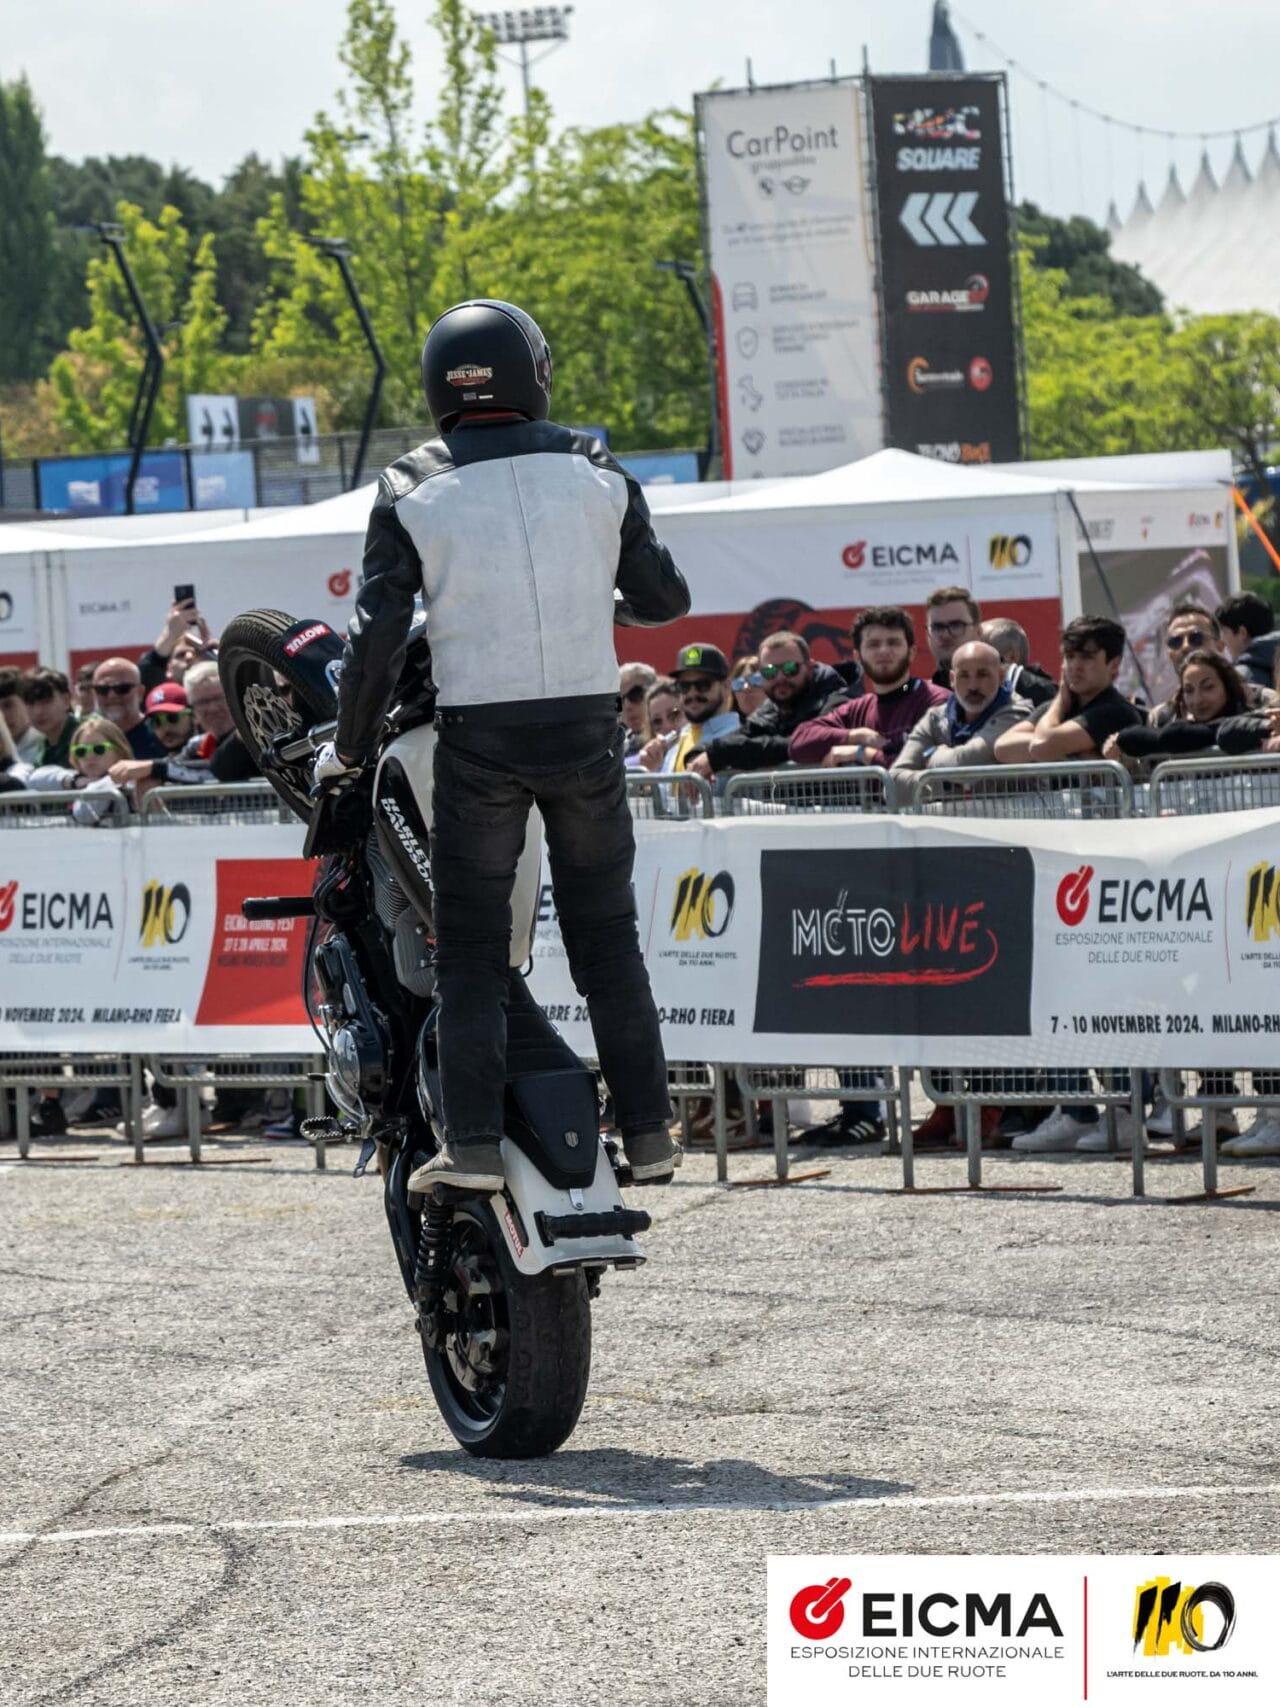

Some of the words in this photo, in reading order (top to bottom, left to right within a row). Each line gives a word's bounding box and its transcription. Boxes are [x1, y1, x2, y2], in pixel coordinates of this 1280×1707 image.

[727, 125, 838, 158] CarPoint
[897, 147, 981, 171] SQUARE
[872, 542, 959, 567] EICMA
[285, 623, 326, 653] MOTUL
[380, 798, 435, 892] DAVIDSON
[387, 797, 431, 868] HARLEY
[22, 892, 114, 930] EICMA
[1098, 877, 1213, 923] EICMA
[1055, 931, 1124, 946] ESPOSIZIONE
[1126, 930, 1214, 945] INTERNAZIONALE
[1088, 951, 1120, 964] DELLE
[1122, 950, 1144, 963] DUE
[1145, 949, 1179, 963] RUOTE
[5, 1007, 55, 1023] NOVEMBRE
[91, 1007, 152, 1023] MILANO-RHO
[154, 1007, 182, 1023] FIERA
[659, 1006, 696, 1025] O-RHO
[700, 1007, 735, 1026] FIERA
[1051, 1015, 1059, 1034] 7
[1072, 1015, 1088, 1034] 10
[1091, 1014, 1162, 1034] NOVEMBRE
[1166, 1014, 1204, 1034] 2024.
